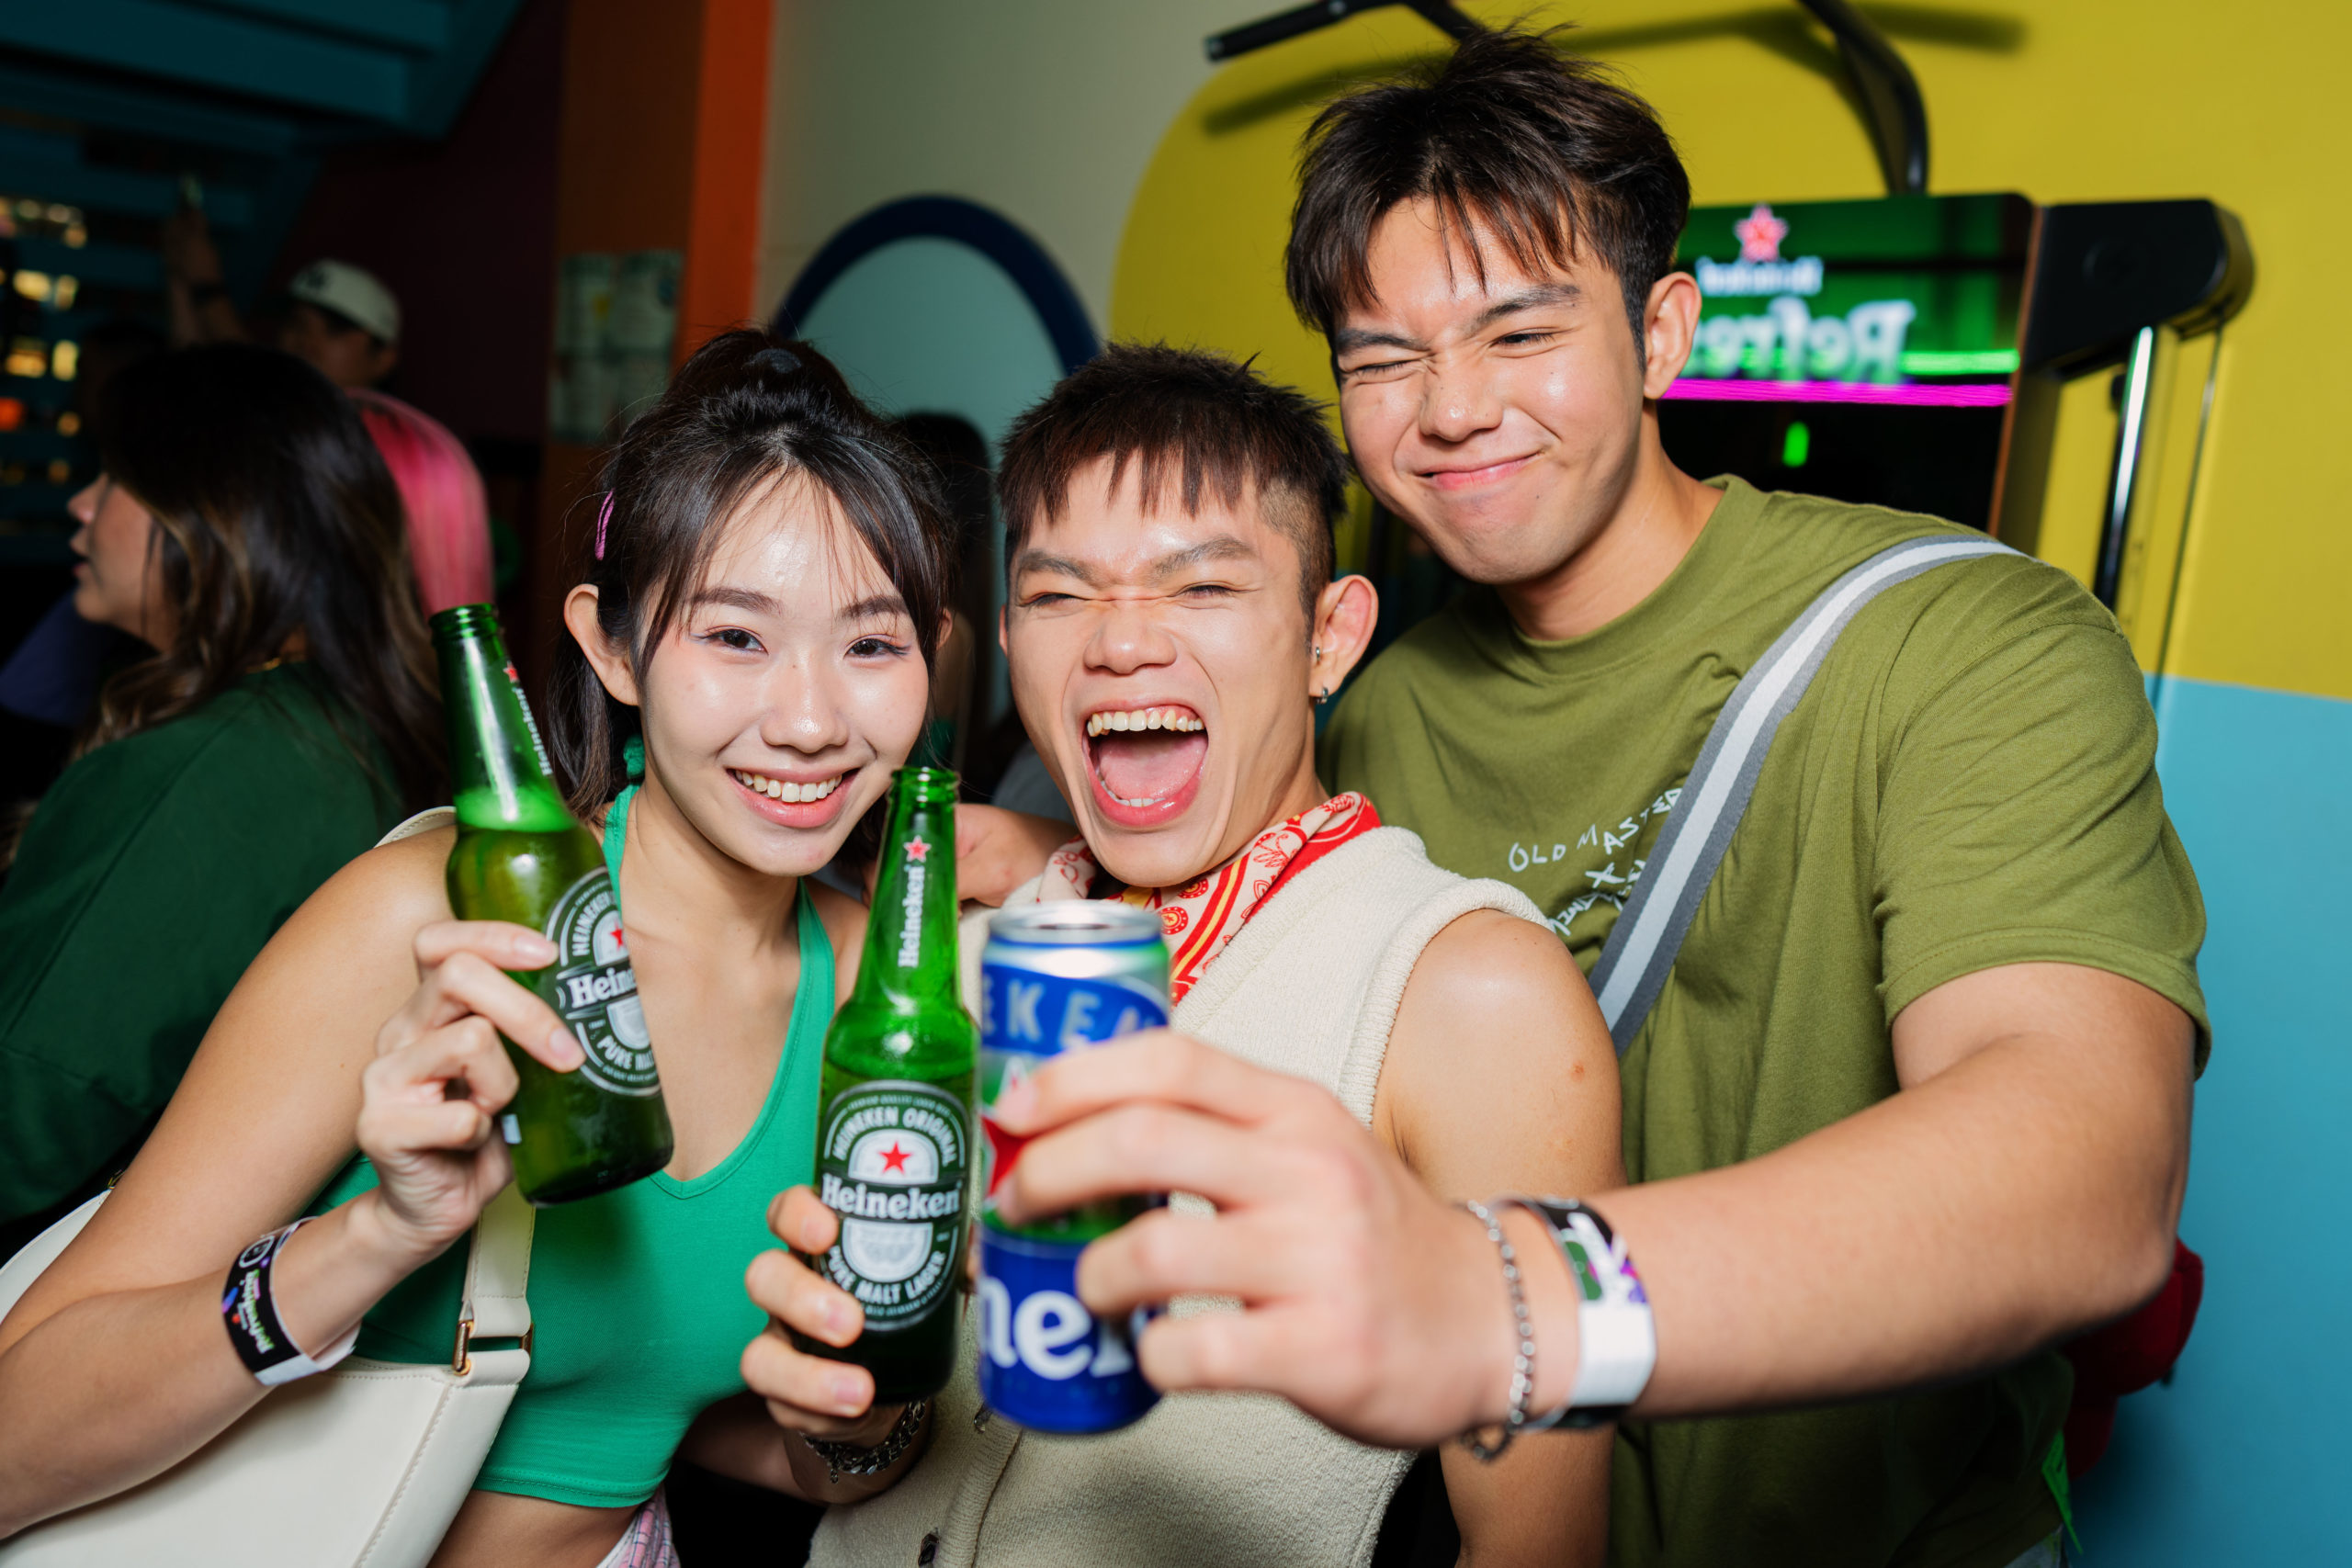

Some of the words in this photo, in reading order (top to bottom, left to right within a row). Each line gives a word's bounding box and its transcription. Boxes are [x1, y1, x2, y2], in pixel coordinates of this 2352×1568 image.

[1509, 842, 1566, 873] OLD
[897, 865, 925, 967] Heineken
[596, 1035, 632, 1070] PURE
[832, 1106, 899, 1161] HEINEKEN
[902, 1107, 956, 1168] ORIGINAL
[821, 1172, 960, 1221] Heineken
[828, 1245, 856, 1292] PURE
[854, 1280, 901, 1305] MALT
[904, 1250, 946, 1300] LAGER
